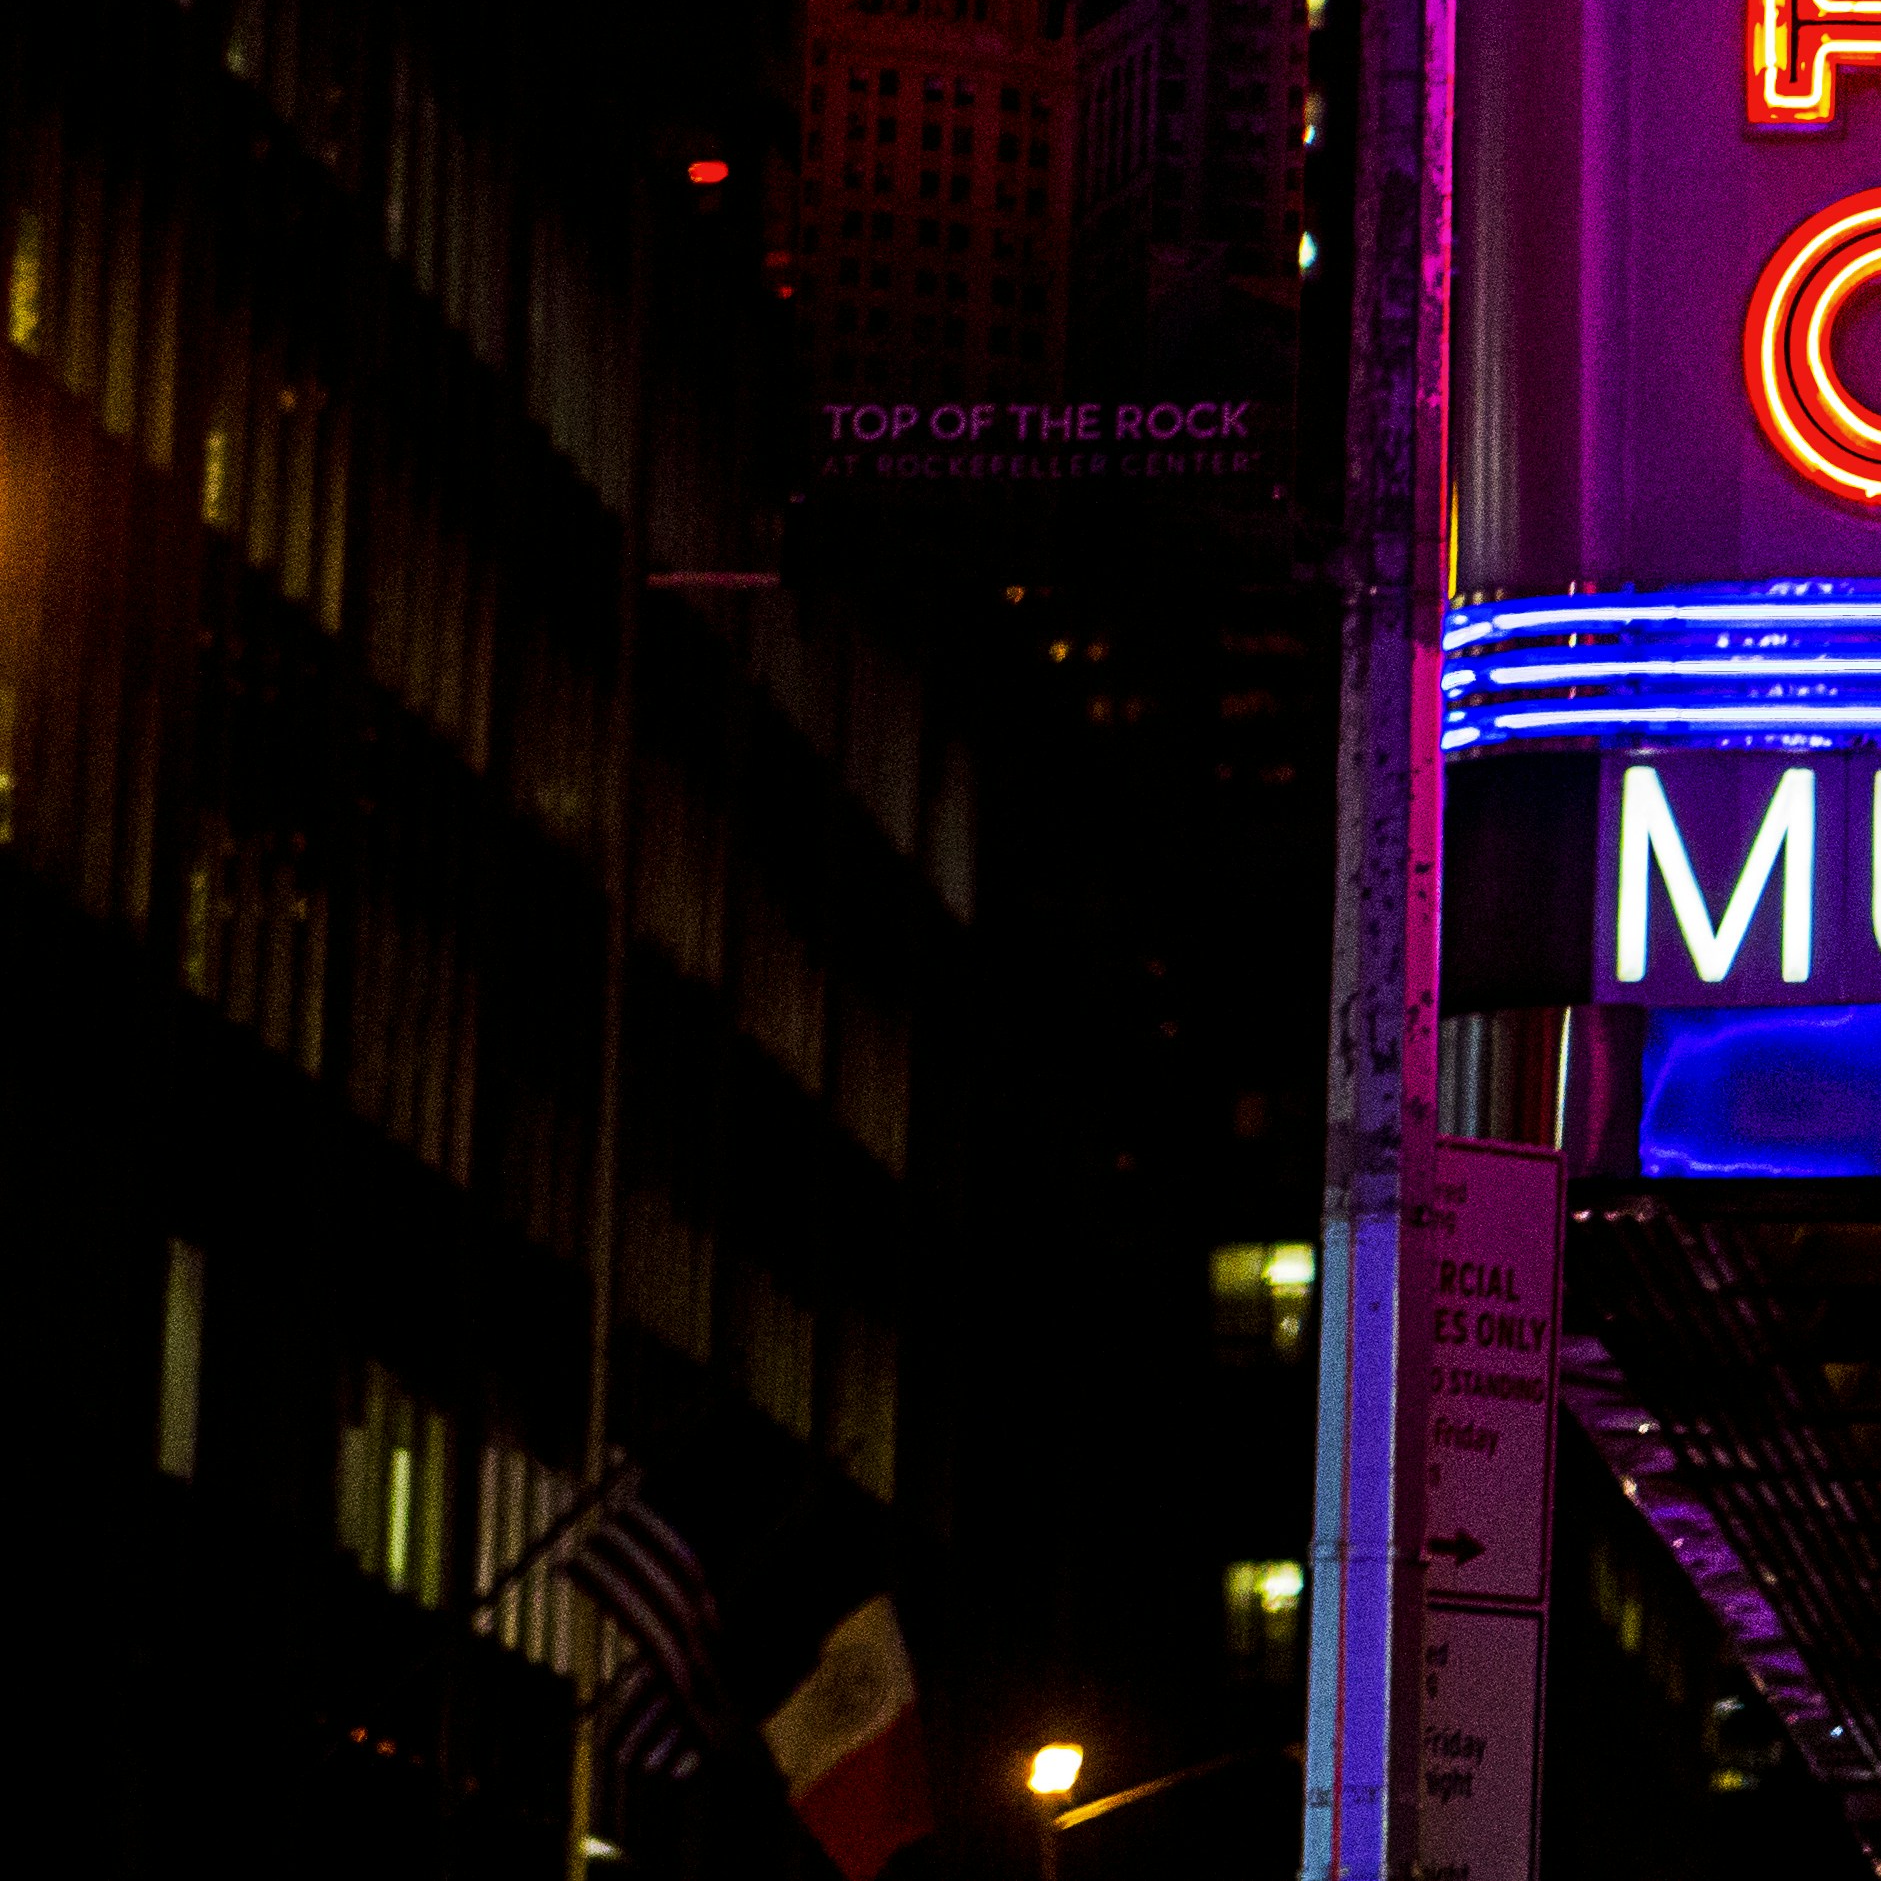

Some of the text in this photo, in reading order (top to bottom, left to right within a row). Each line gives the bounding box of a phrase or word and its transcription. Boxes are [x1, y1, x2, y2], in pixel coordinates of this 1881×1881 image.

[822, 400, 1250, 442] TOP OF THE ROCK
[820, 454, 862, 478] AT
[875, 451, 1109, 480] ROCKEFELLER
[1475, 1310, 1547, 1353] ONLY
[1449, 1368, 1545, 1404] STANDING
